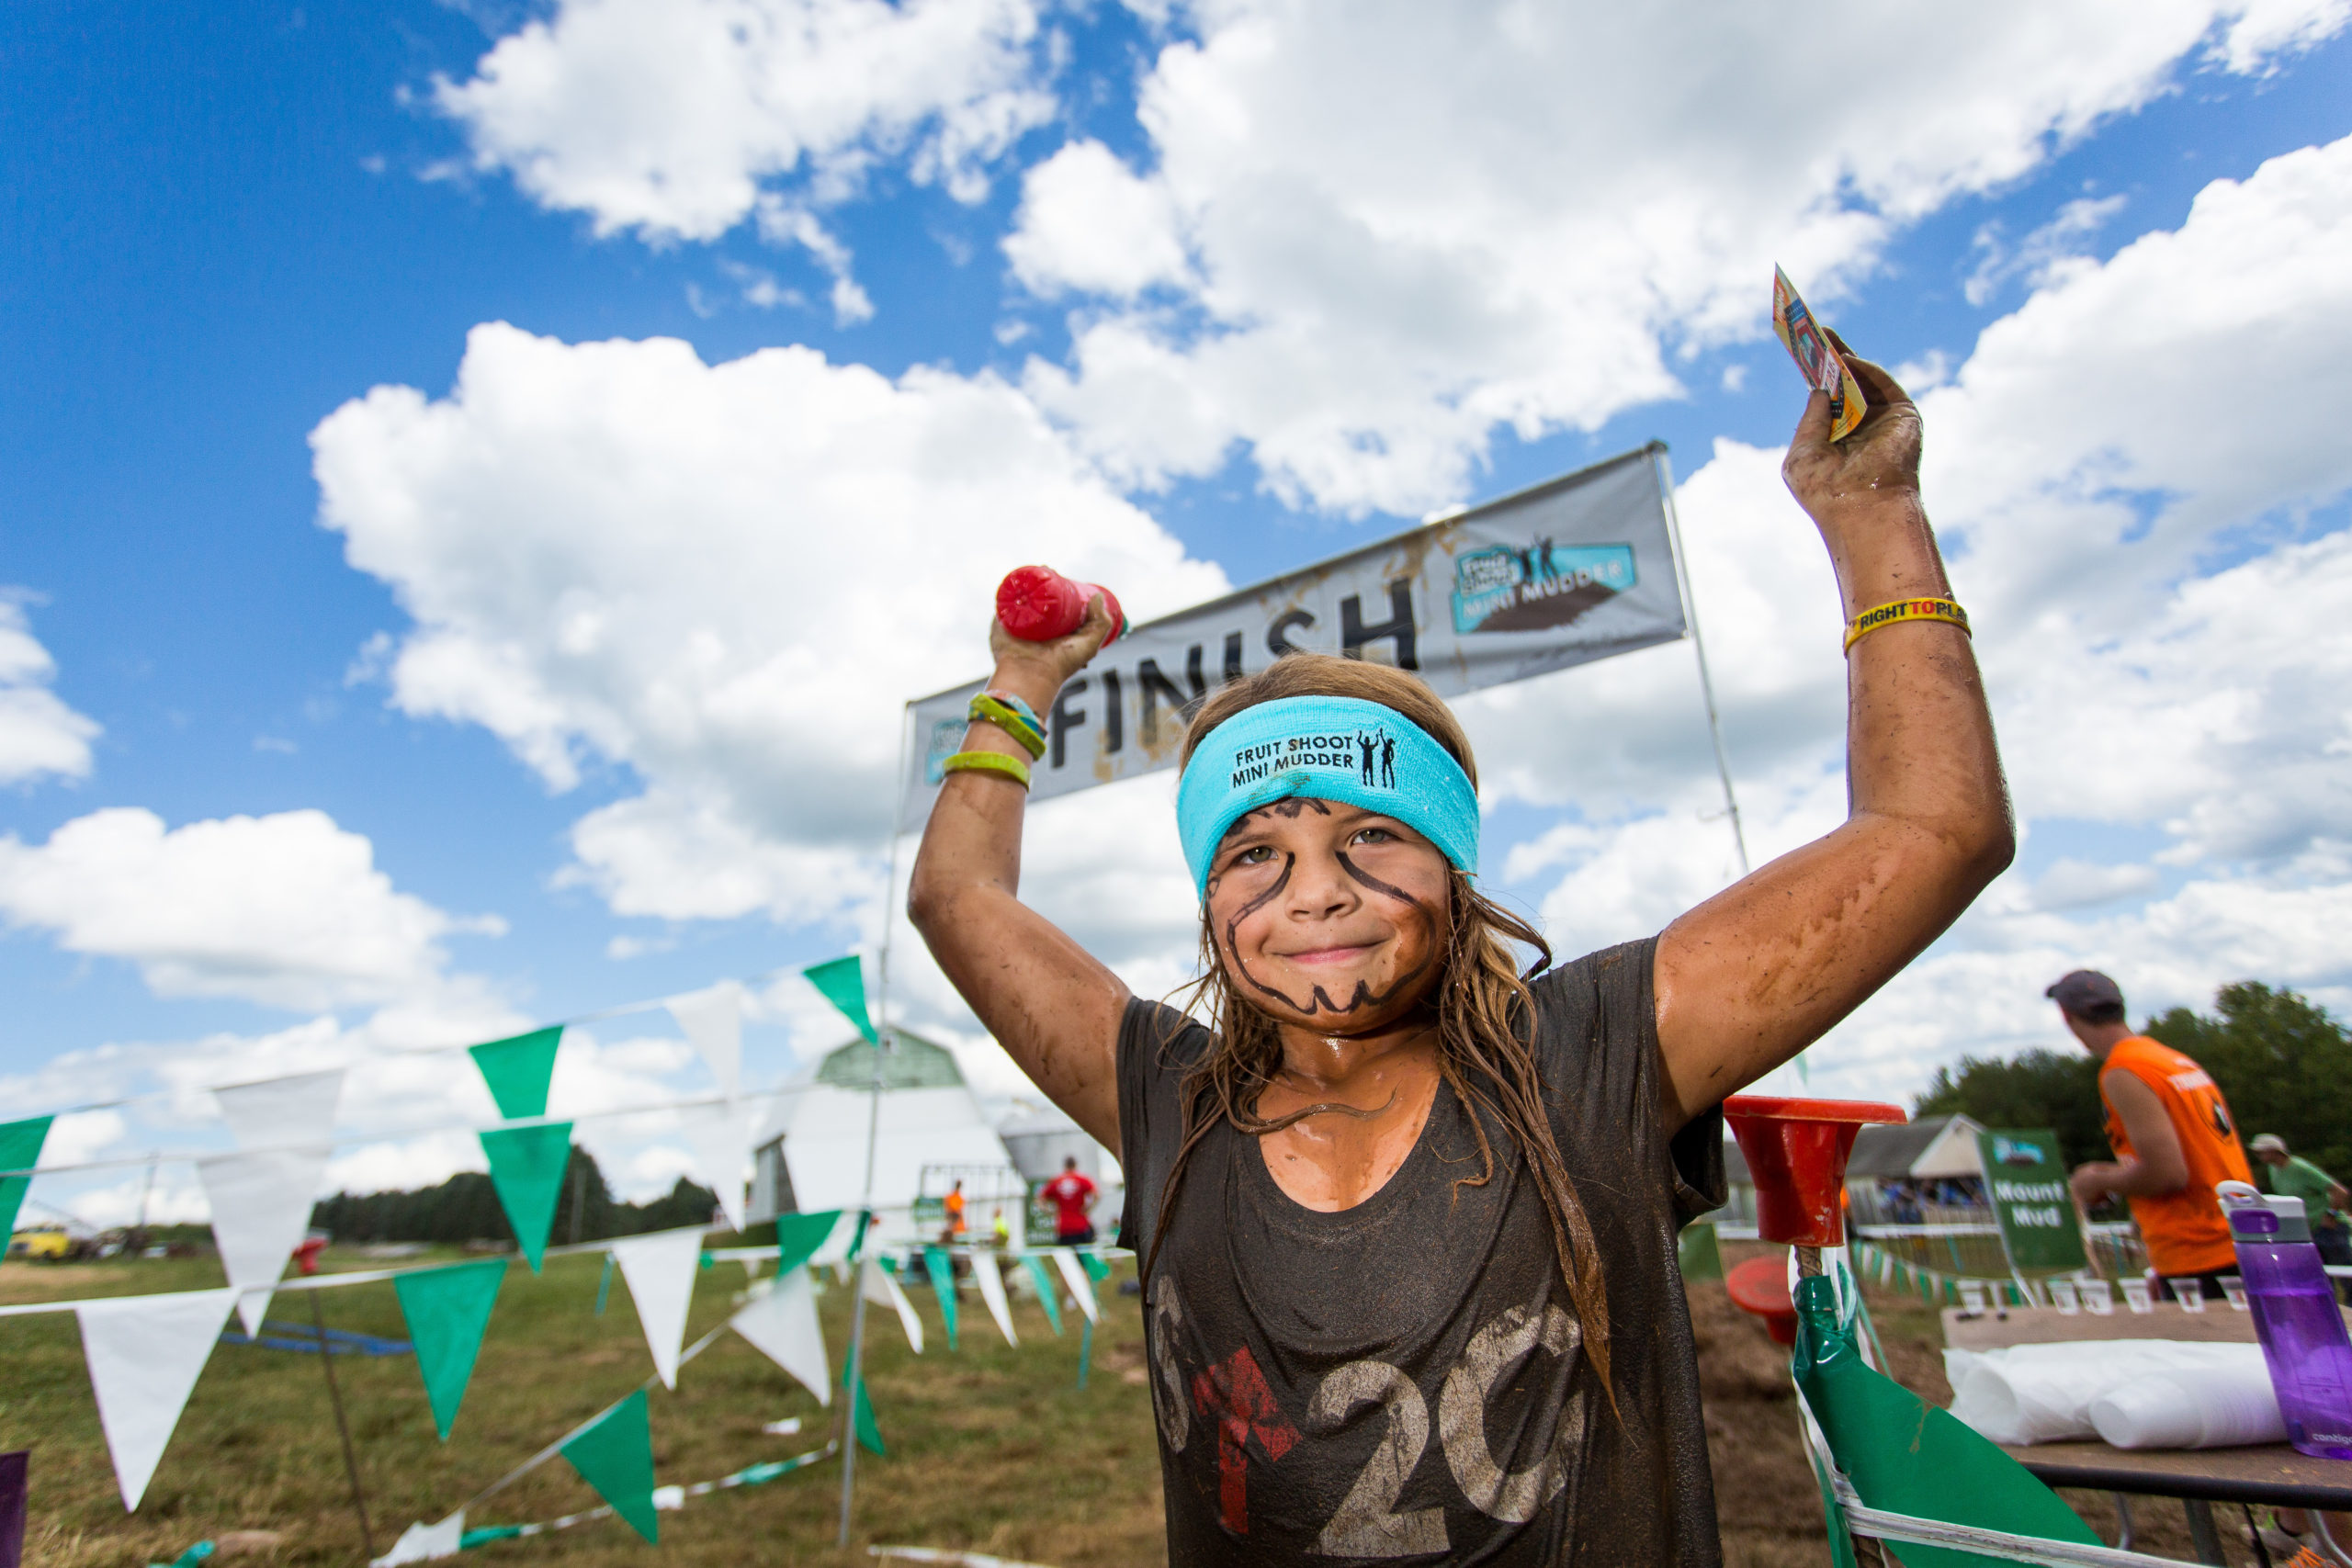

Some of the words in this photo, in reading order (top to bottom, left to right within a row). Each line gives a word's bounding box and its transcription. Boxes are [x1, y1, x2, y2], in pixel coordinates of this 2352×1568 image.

[1521, 559, 1623, 604] MUDDER
[1860, 603, 1908, 630] RIGHT
[1909, 601, 1935, 615] TO
[1236, 741, 1281, 767] FRUIT
[1288, 735, 1352, 750] SHOOT
[1232, 762, 1269, 788] MINI
[1274, 753, 1353, 773] MUDDER
[1995, 1179, 2064, 1202] Mount
[2011, 1204, 2062, 1227] Mud
